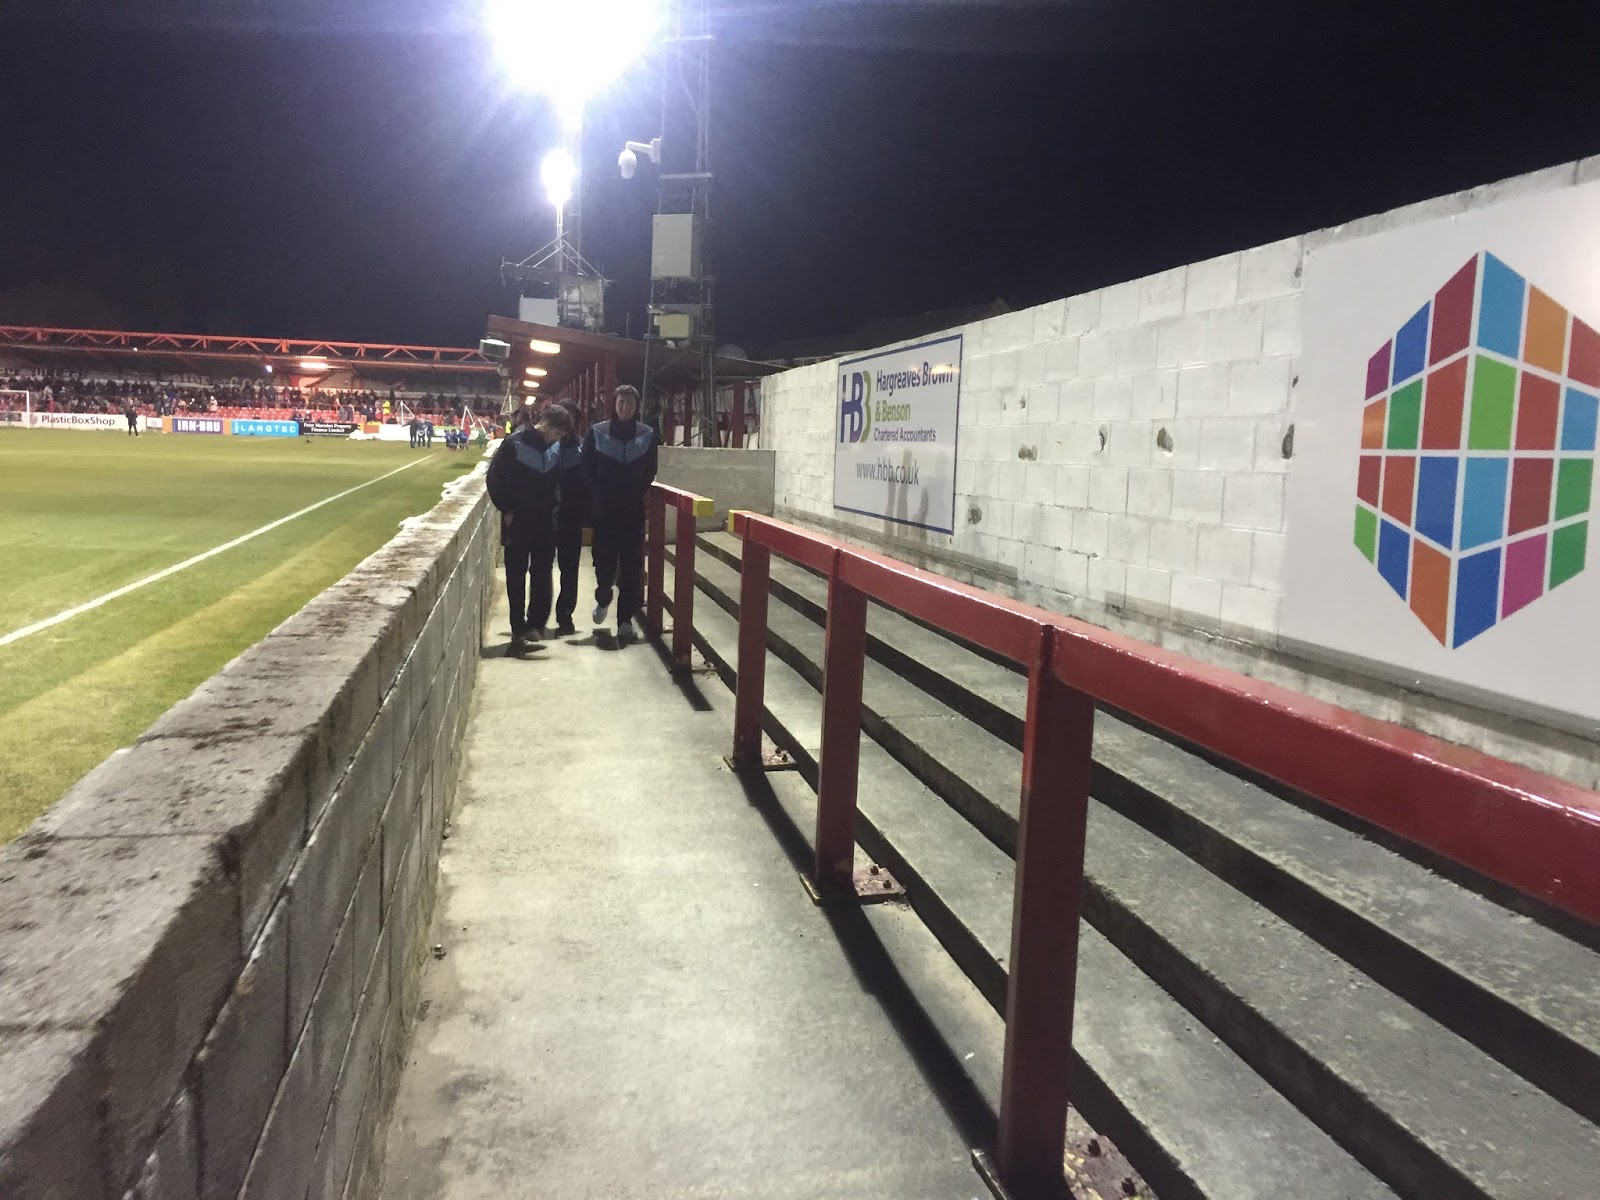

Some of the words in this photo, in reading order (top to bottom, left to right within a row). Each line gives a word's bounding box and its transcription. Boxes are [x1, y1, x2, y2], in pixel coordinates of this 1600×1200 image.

[876, 370, 921, 397] Hargreaves
[922, 362, 953, 386] Brown
[875, 401, 881, 422] &
[882, 400, 911, 422] Benson
[41, 415, 115, 426] PlasticBoxShop
[177, 420, 221, 432] IRN-BRU
[874, 427, 899, 442] Chartered
[899, 427, 937, 442] Accountants
[856, 457, 920, 485] www.hbb.co.uk
